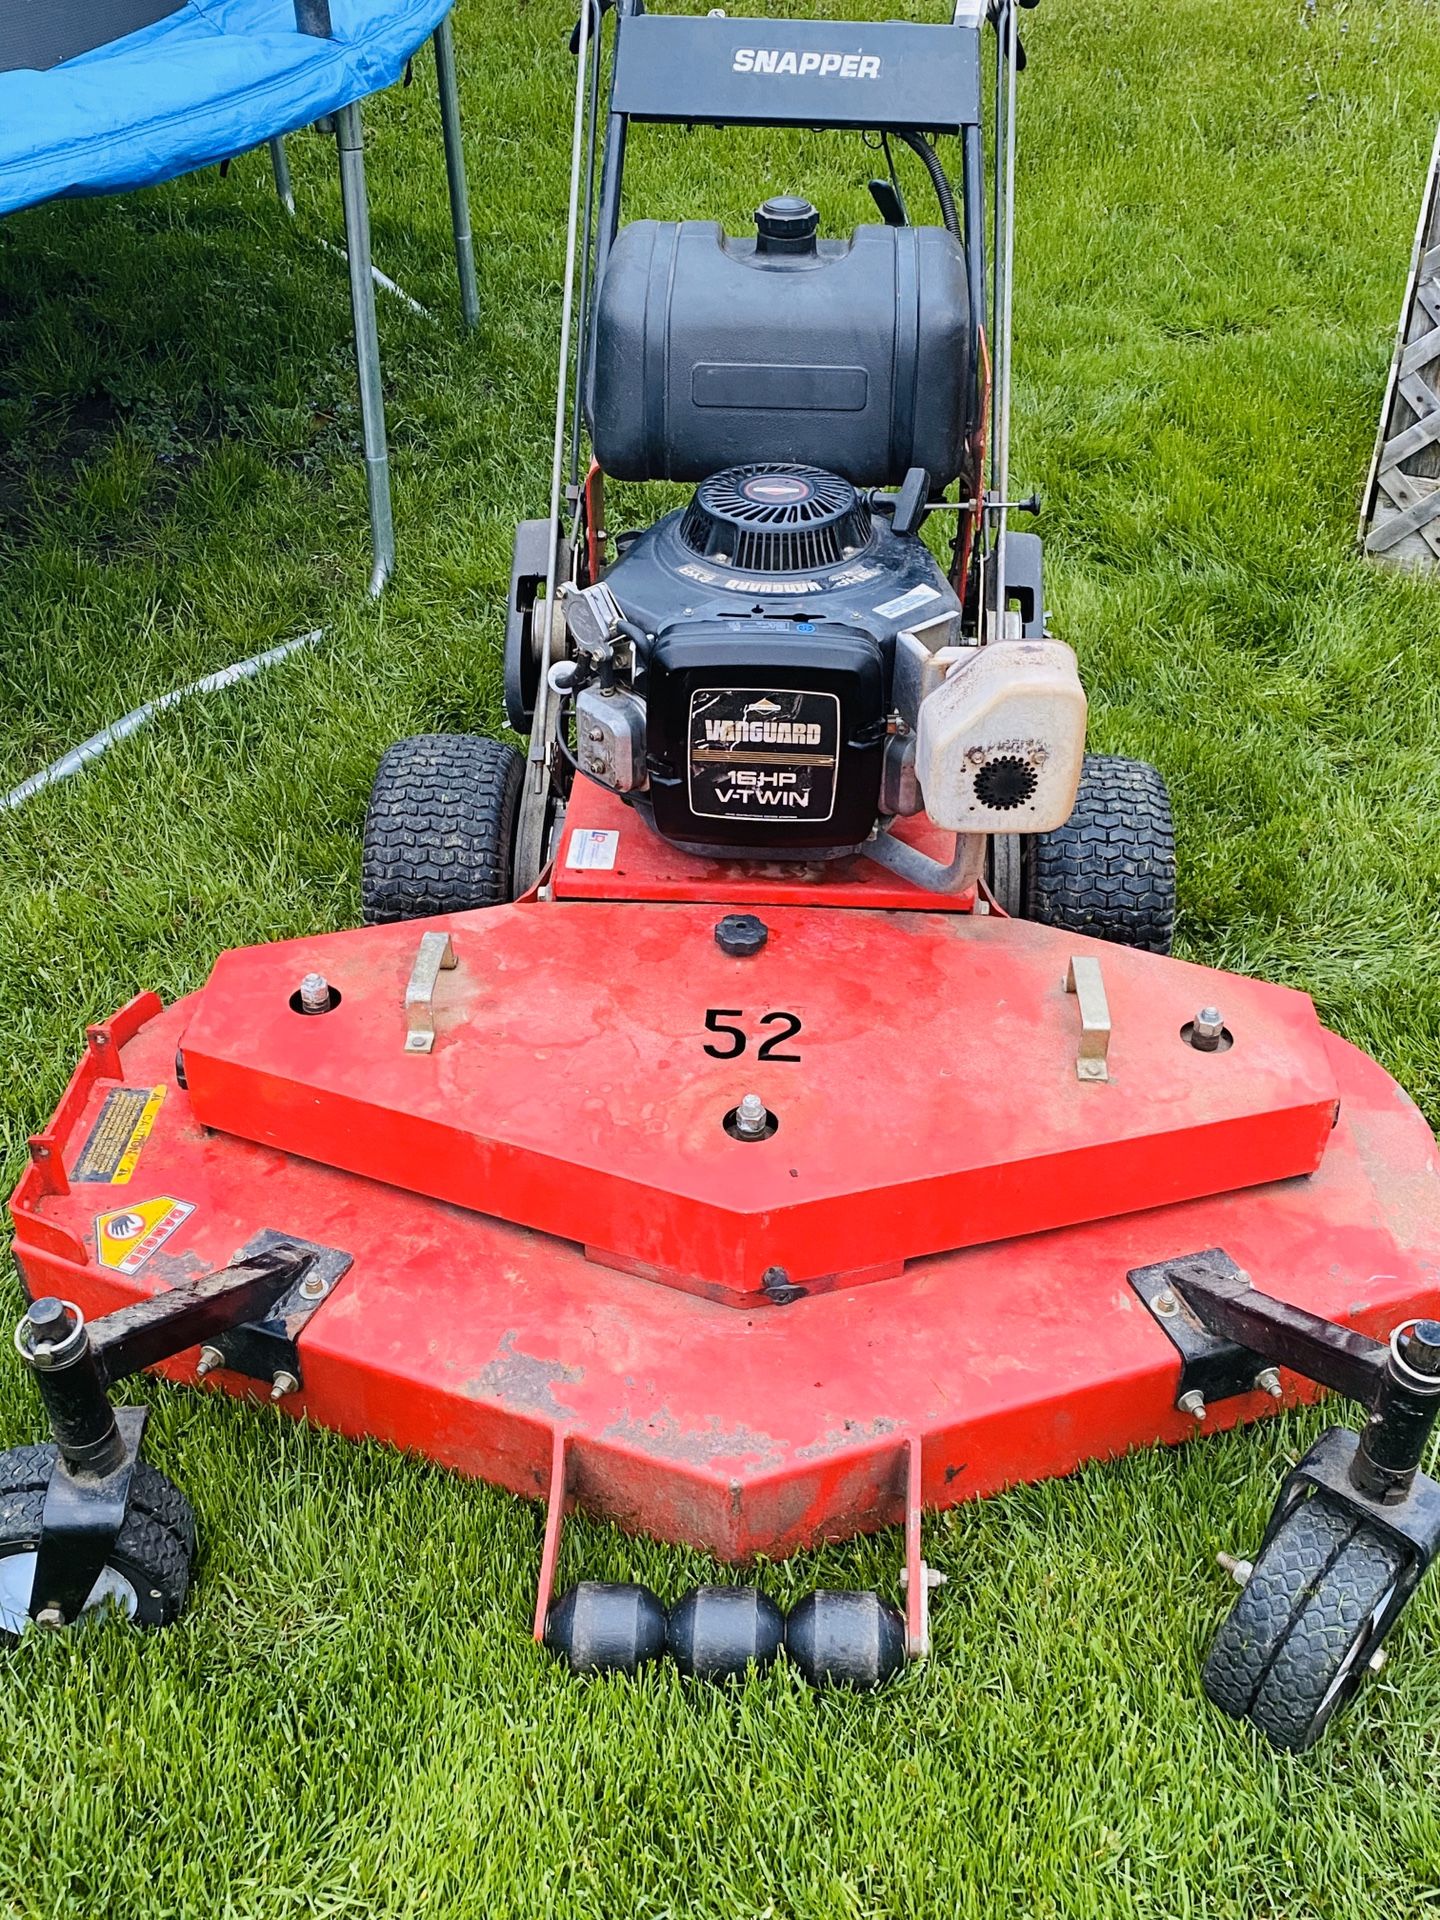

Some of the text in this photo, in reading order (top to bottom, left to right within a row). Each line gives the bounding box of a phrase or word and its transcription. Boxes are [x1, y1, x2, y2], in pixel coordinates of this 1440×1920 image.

[732, 48, 880, 79] SNAPPER
[704, 719, 821, 745] VANGUARD
[727, 770, 797, 787] 16HP
[714, 788, 811, 807] V-TWIN
[703, 1008, 802, 1063] 52
[129, 1114, 153, 1157] CAUTION
[125, 1208, 187, 1266] DANGER
